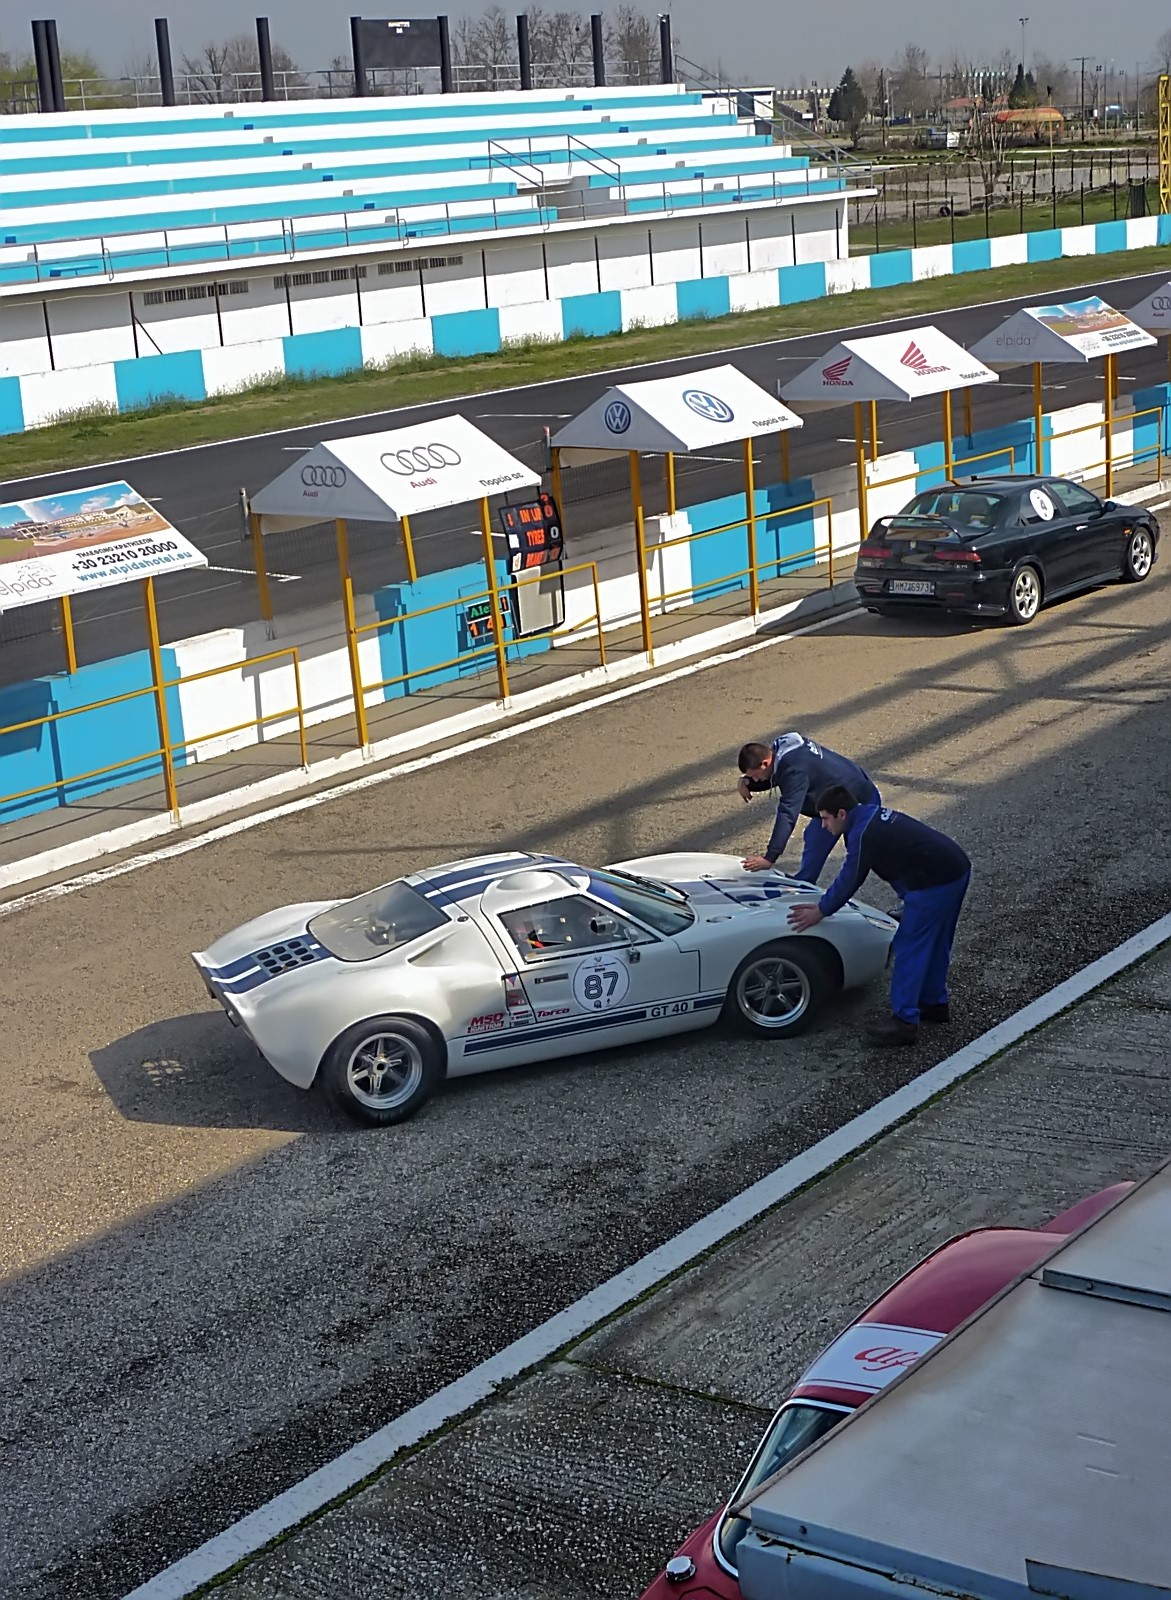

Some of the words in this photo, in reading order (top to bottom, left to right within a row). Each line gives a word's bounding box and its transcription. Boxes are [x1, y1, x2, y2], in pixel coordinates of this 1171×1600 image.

[996, 332, 1031, 349] elpida
[913, 365, 951, 376] HONDA
[410, 477, 438, 489] Audi
[478, 474, 512, 487] Πορεία
[72, 559, 98, 571] +30
[97, 550, 138, 566] 23210
[138, 541, 178, 557] 20000
[76, 546, 114, 559] ΤΗΛΕΦΩΝΟ
[114, 537, 154, 550] ΚΡΑΤΗΣΕΩΝ
[77, 550, 193, 582] www.elpidahotel.eu
[584, 971, 619, 1000] 87
[650, 1005, 669, 1018] GT
[672, 1002, 689, 1014] 40
[469, 1021, 503, 1033] IGNITION
[470, 1012, 505, 1026] MSD
